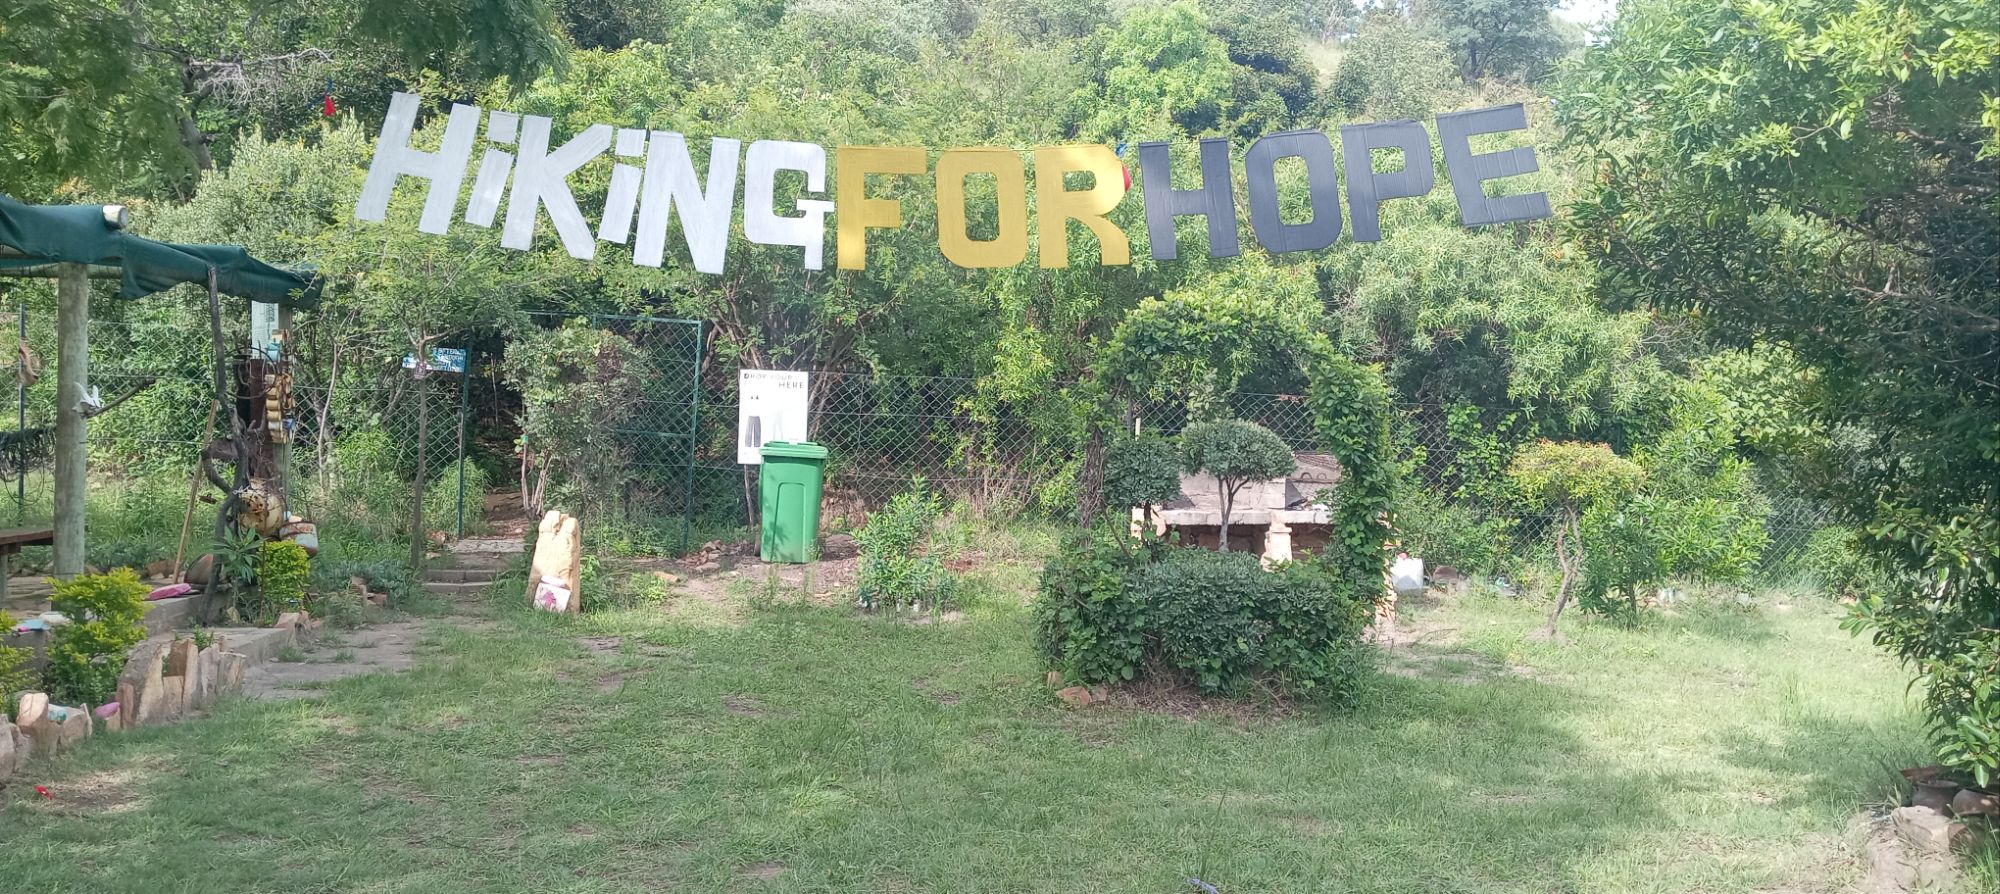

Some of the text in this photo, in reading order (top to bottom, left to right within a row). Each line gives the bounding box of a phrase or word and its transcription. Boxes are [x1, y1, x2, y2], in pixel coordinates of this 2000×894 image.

[837, 144, 1130, 270] FOR
[1139, 103, 1553, 260] HOPE
[778, 381, 805, 389] HERE
